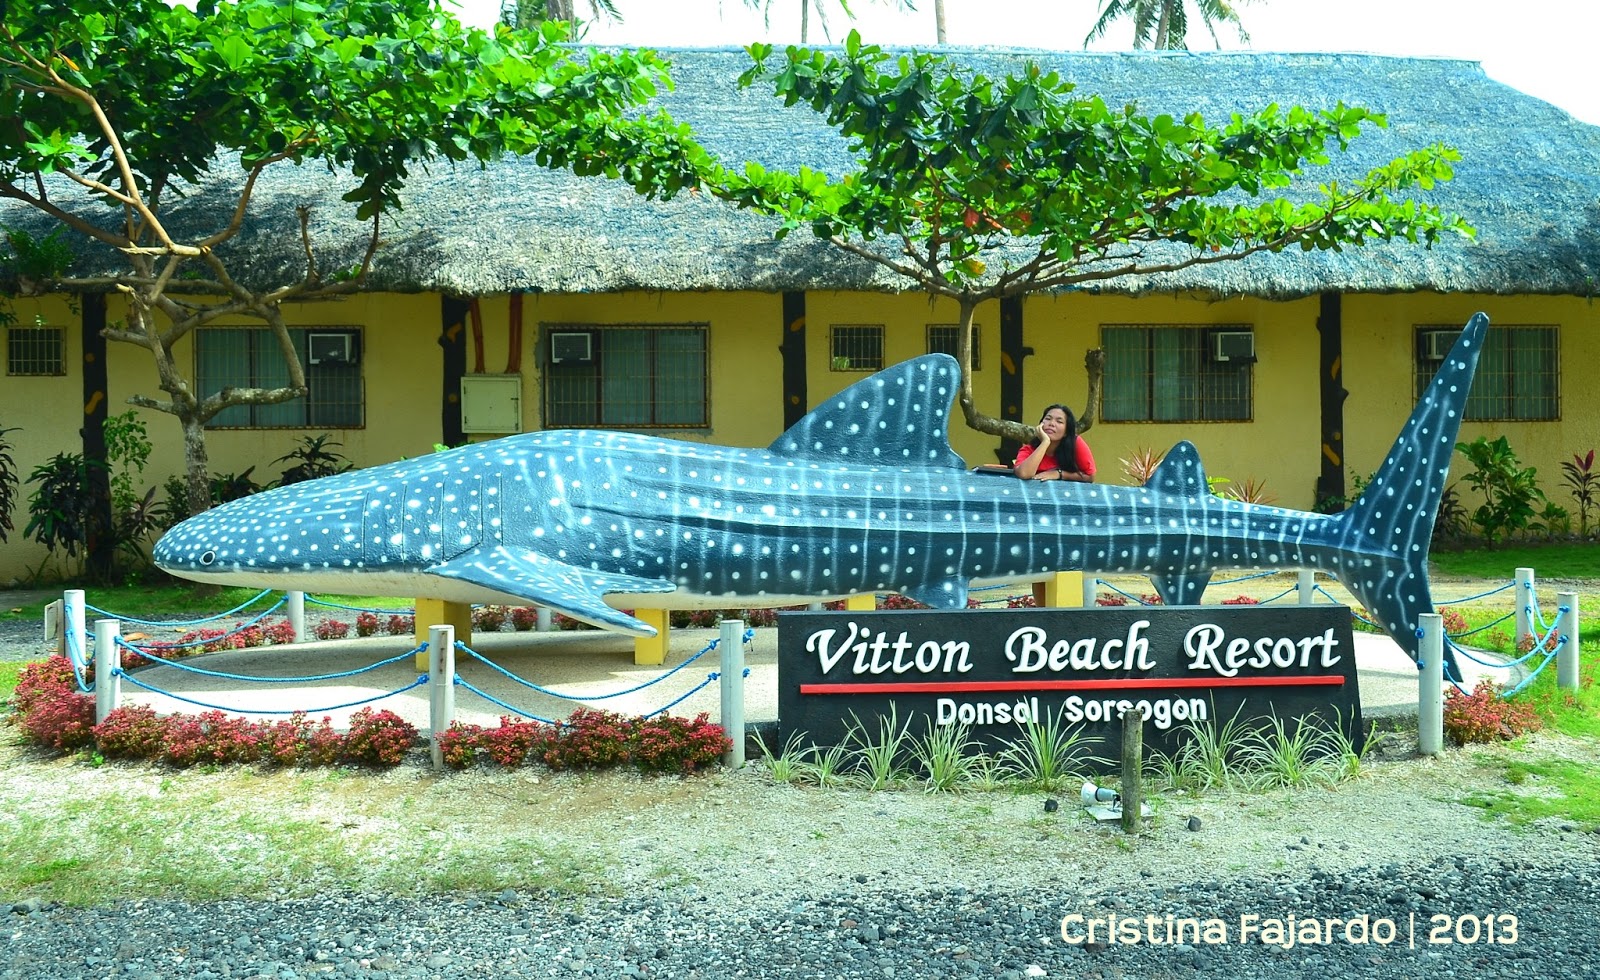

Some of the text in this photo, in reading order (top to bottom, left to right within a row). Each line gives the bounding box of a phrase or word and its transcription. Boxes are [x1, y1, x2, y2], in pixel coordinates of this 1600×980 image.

[805, 620, 1341, 677] Vitton Beach Resort
[936, 697, 1039, 726] Donsol
